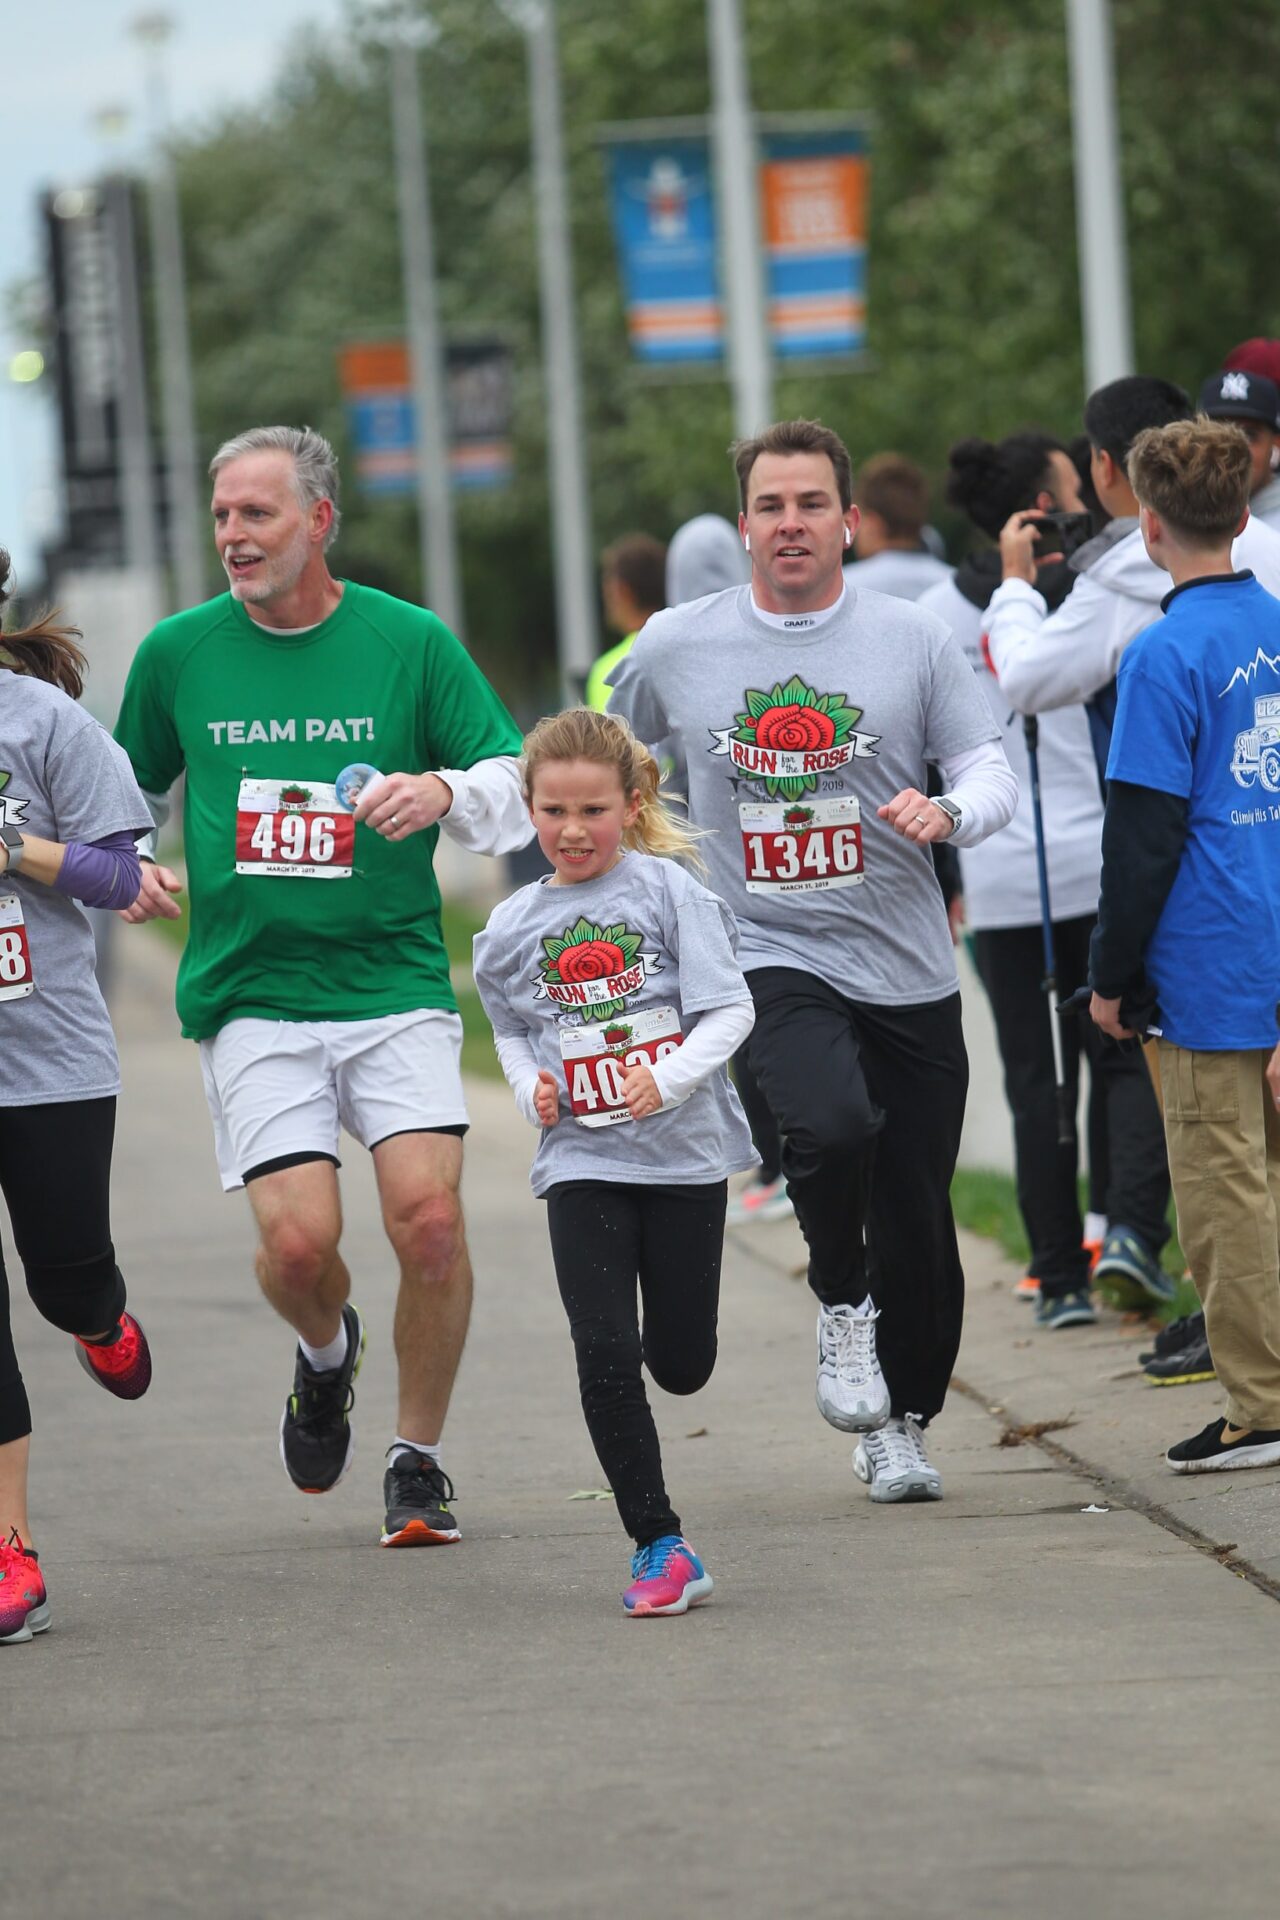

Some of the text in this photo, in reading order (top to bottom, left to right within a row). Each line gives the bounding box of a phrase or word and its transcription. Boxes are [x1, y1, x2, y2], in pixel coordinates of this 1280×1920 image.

[784, 619, 808, 627] CRAFT
[207, 717, 376, 745] TEAM PAT!
[733, 742, 851, 775] RUN for the ROSE
[822, 780, 844, 792] 2019
[250, 813, 337, 863] 496
[748, 828, 859, 880] 1346
[266, 865, 290, 873] MARCH
[780, 883, 804, 891] MARCH
[815, 880, 829, 889] 2019
[546, 965, 644, 1005] RUN for the ROSE
[571, 1039, 680, 1110] 40
[610, 1111, 632, 1120] MARC
